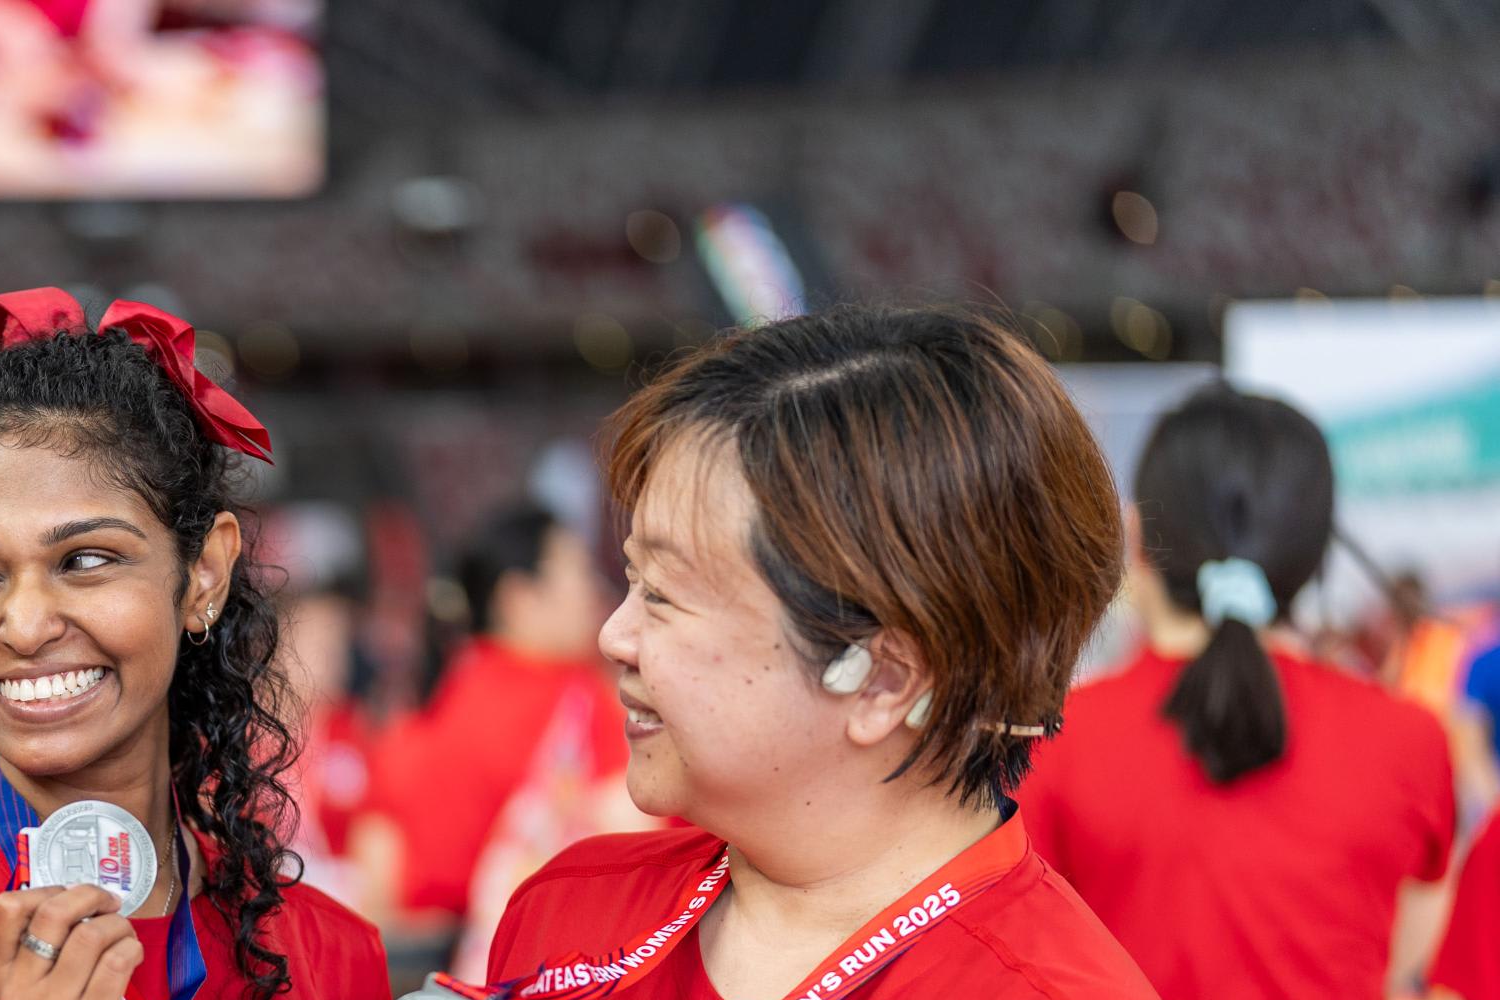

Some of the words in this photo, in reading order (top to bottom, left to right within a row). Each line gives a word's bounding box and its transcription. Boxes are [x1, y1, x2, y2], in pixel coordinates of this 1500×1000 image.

[100, 858, 120, 885] 10
[119, 832, 131, 892] FINISHER
[618, 896, 707, 968] WOMEN'S
[838, 928, 896, 976] RUN
[892, 882, 961, 937] 2025
